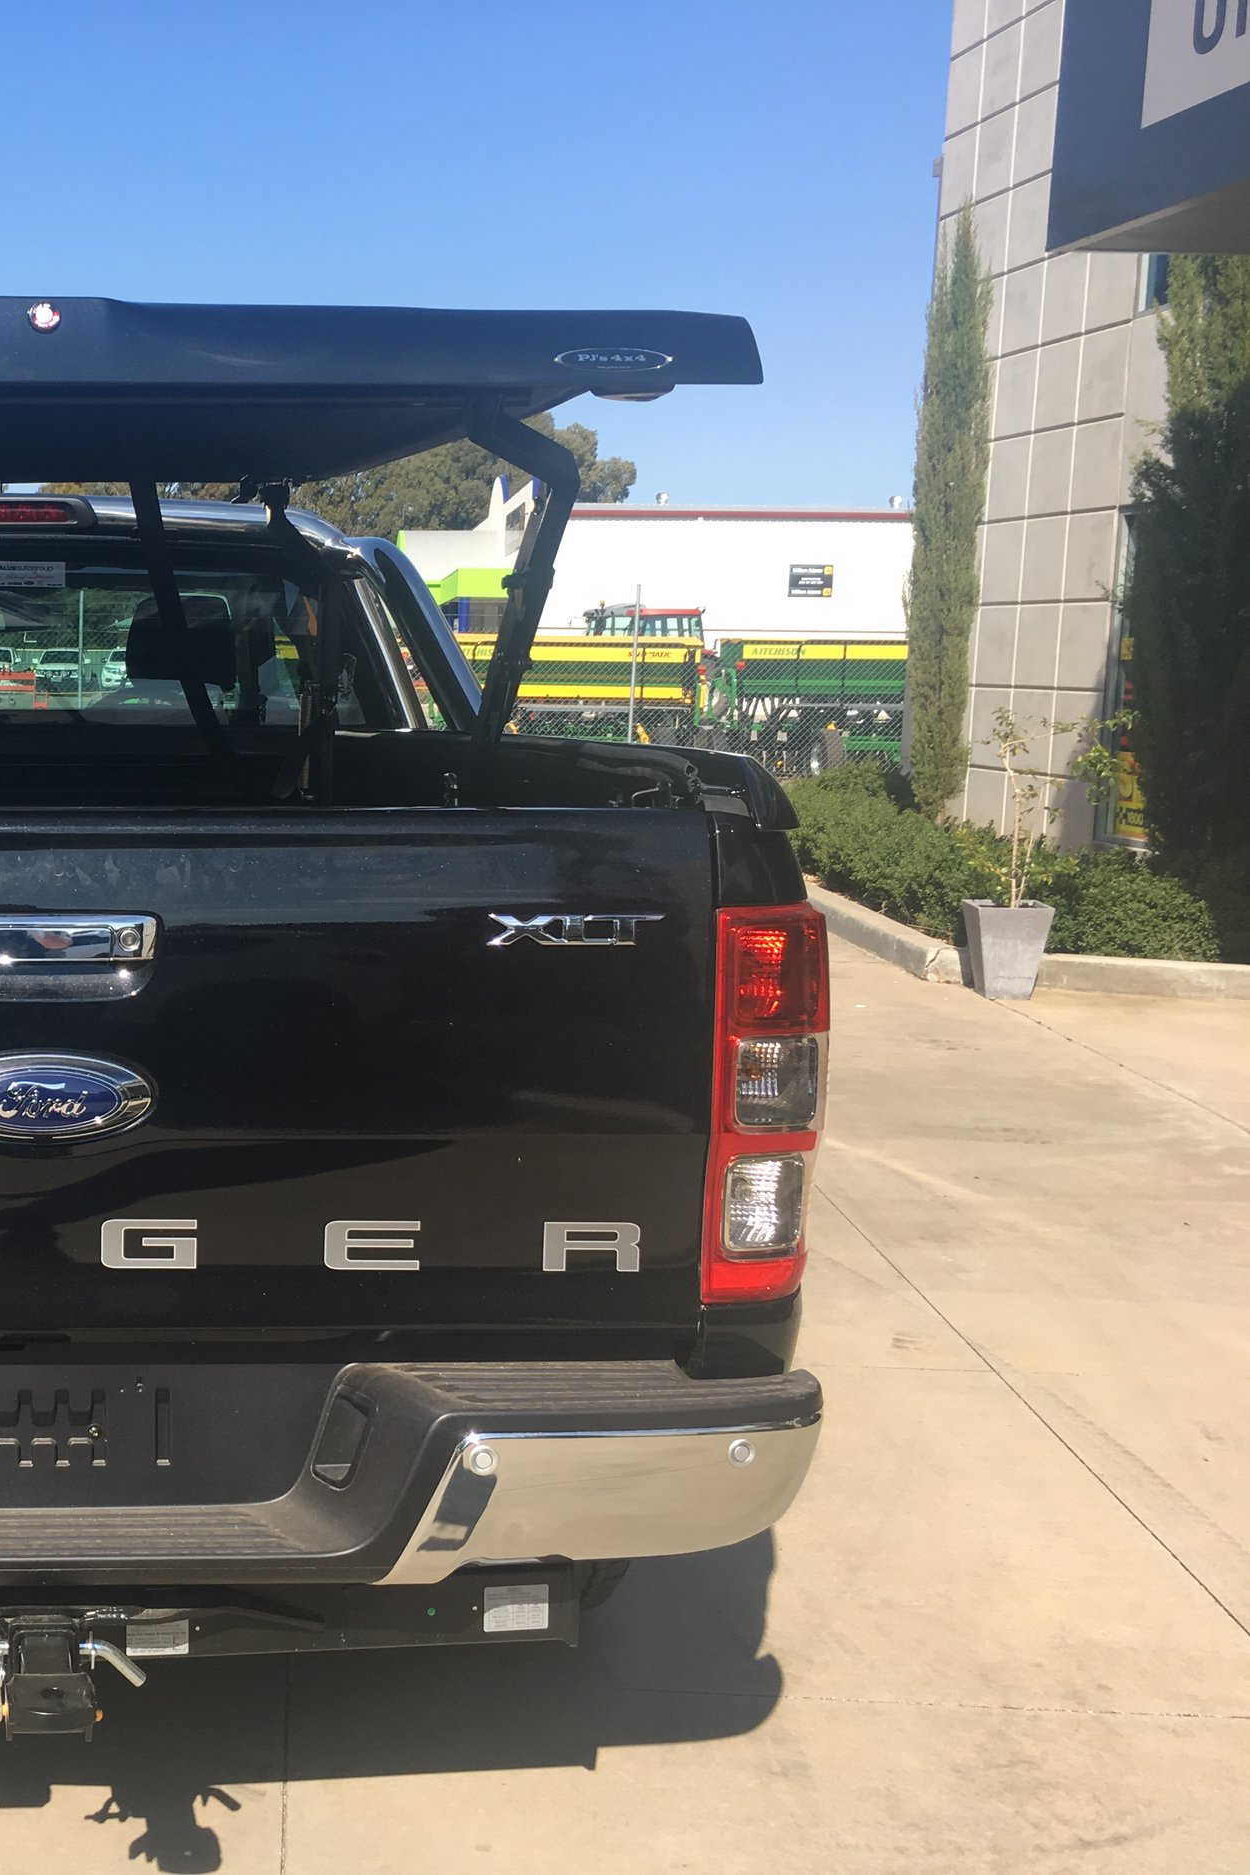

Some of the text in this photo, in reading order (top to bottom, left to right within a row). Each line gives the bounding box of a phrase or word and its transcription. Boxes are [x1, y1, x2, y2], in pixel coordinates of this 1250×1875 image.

[751, 647, 807, 656] AITCHISON
[1127, 812, 1144, 825] 1800
[486, 914, 666, 946] XLT
